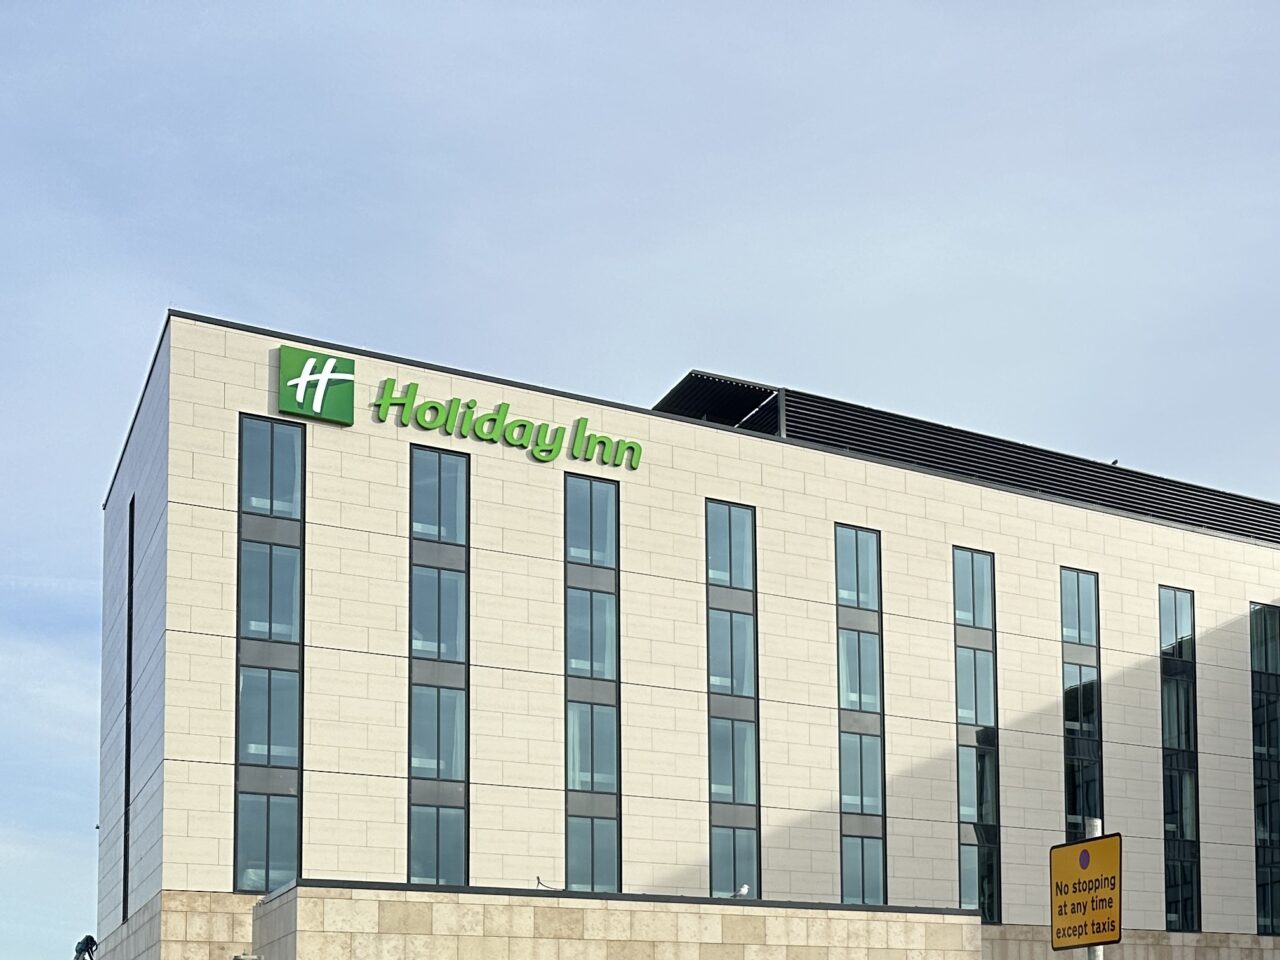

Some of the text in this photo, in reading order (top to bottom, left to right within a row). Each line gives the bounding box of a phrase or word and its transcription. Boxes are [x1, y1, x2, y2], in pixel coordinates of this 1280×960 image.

[373, 377, 643, 471] Holiday Inn
[1055, 874, 1116, 896] No stopping
[1057, 895, 1113, 916] at any time
[1056, 917, 1116, 939] except taxis
